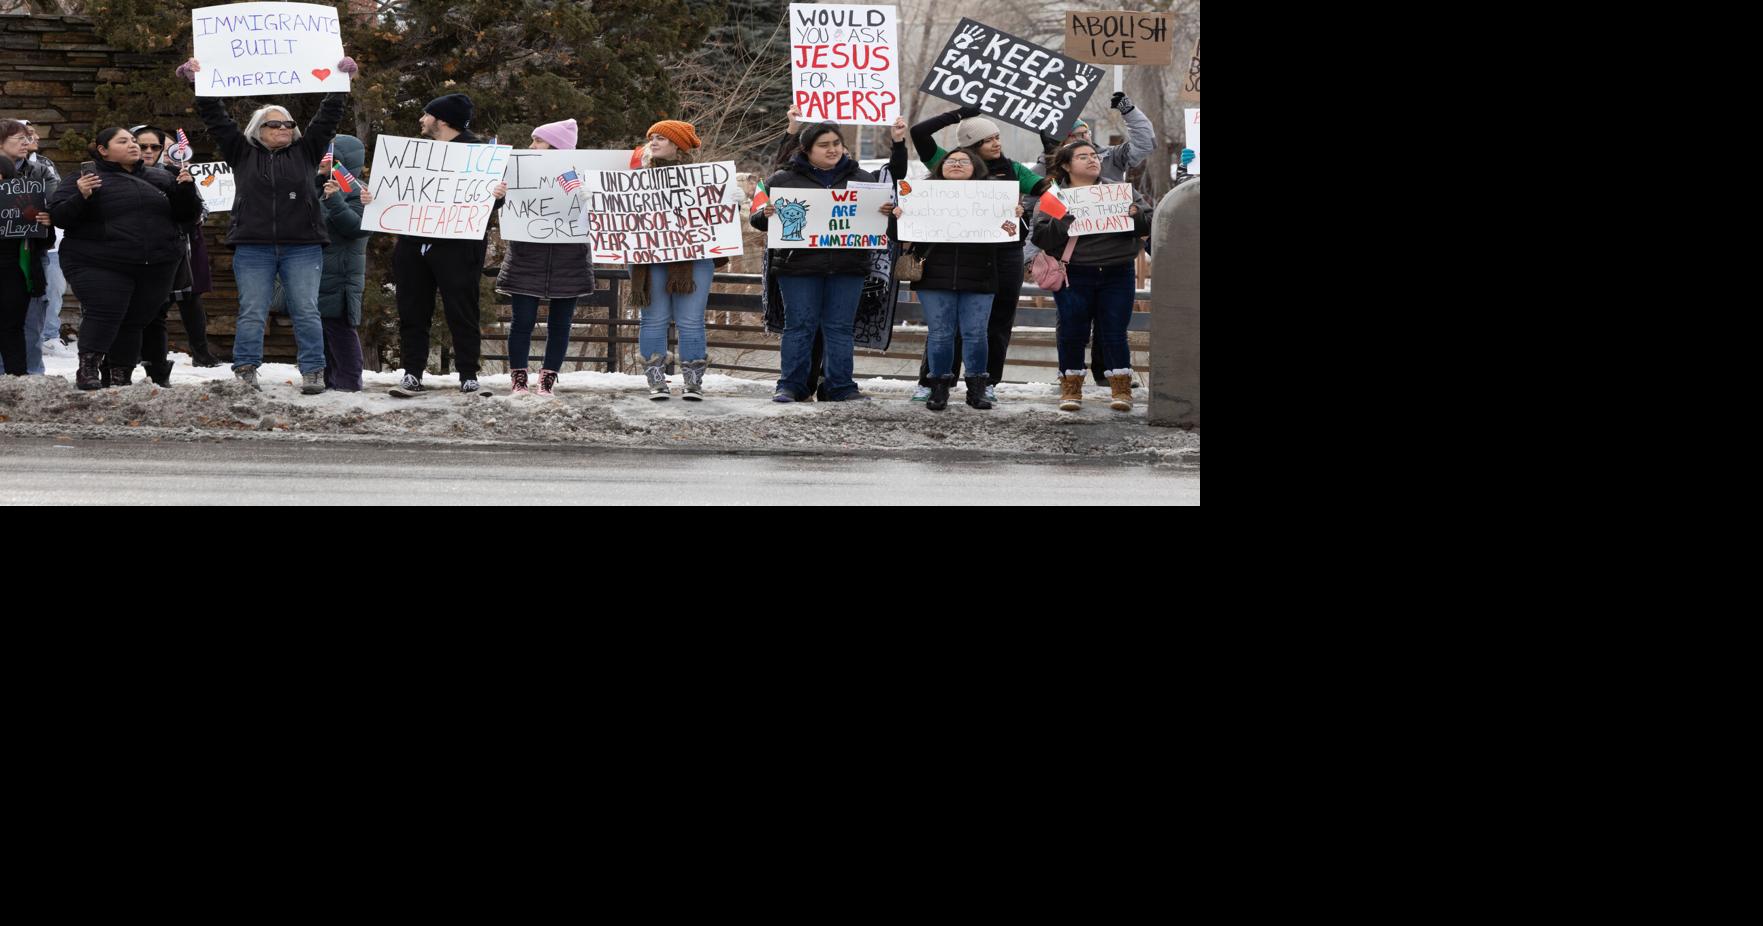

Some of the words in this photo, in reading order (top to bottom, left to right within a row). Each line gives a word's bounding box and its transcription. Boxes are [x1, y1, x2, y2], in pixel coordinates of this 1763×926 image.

[197, 13, 339, 36] IMMIGRANTS
[797, 9, 885, 27] WOULD
[1072, 14, 1167, 42] ABOLISH
[796, 27, 829, 44] YOU
[848, 27, 888, 43] ASK
[230, 39, 297, 58] BUILT
[794, 43, 890, 71] JESUS
[982, 33, 1065, 79] KEEP
[1091, 39, 1136, 58] ICE
[800, 72, 835, 88] FOR
[846, 72, 885, 89] HIS
[941, 48, 1077, 110] FAMILIES
[795, 90, 896, 122] PAPERS?
[928, 66, 1064, 136] TOGETHER
[383, 137, 454, 172] WILL
[460, 144, 511, 174] ICE
[374, 175, 449, 203] MAKE
[453, 178, 498, 204] EGGS
[590, 188, 696, 213] IMMIGRANTS
[696, 184, 726, 206] PAY
[831, 190, 858, 202] WE
[1062, 187, 1084, 205] WE
[1089, 184, 1131, 202] SPEAK
[501, 197, 561, 218] MAKE
[588, 211, 653, 232] BILLIONS
[653, 210, 672, 231] OF
[673, 206, 687, 231] $
[688, 204, 736, 228] EVERY
[831, 204, 857, 217] ARE
[1096, 203, 1130, 216] THOSE
[379, 204, 490, 234] CHEAPER?
[527, 218, 590, 239] GRE
[828, 219, 850, 231] ALL
[590, 230, 630, 251] YEAR
[631, 231, 660, 250] IN
[659, 226, 717, 247] TAXES!
[808, 233, 887, 247] IMMIGRANTS
[623, 249, 661, 264] LOOK
[659, 247, 678, 261] IT
[682, 244, 705, 260] UP!
